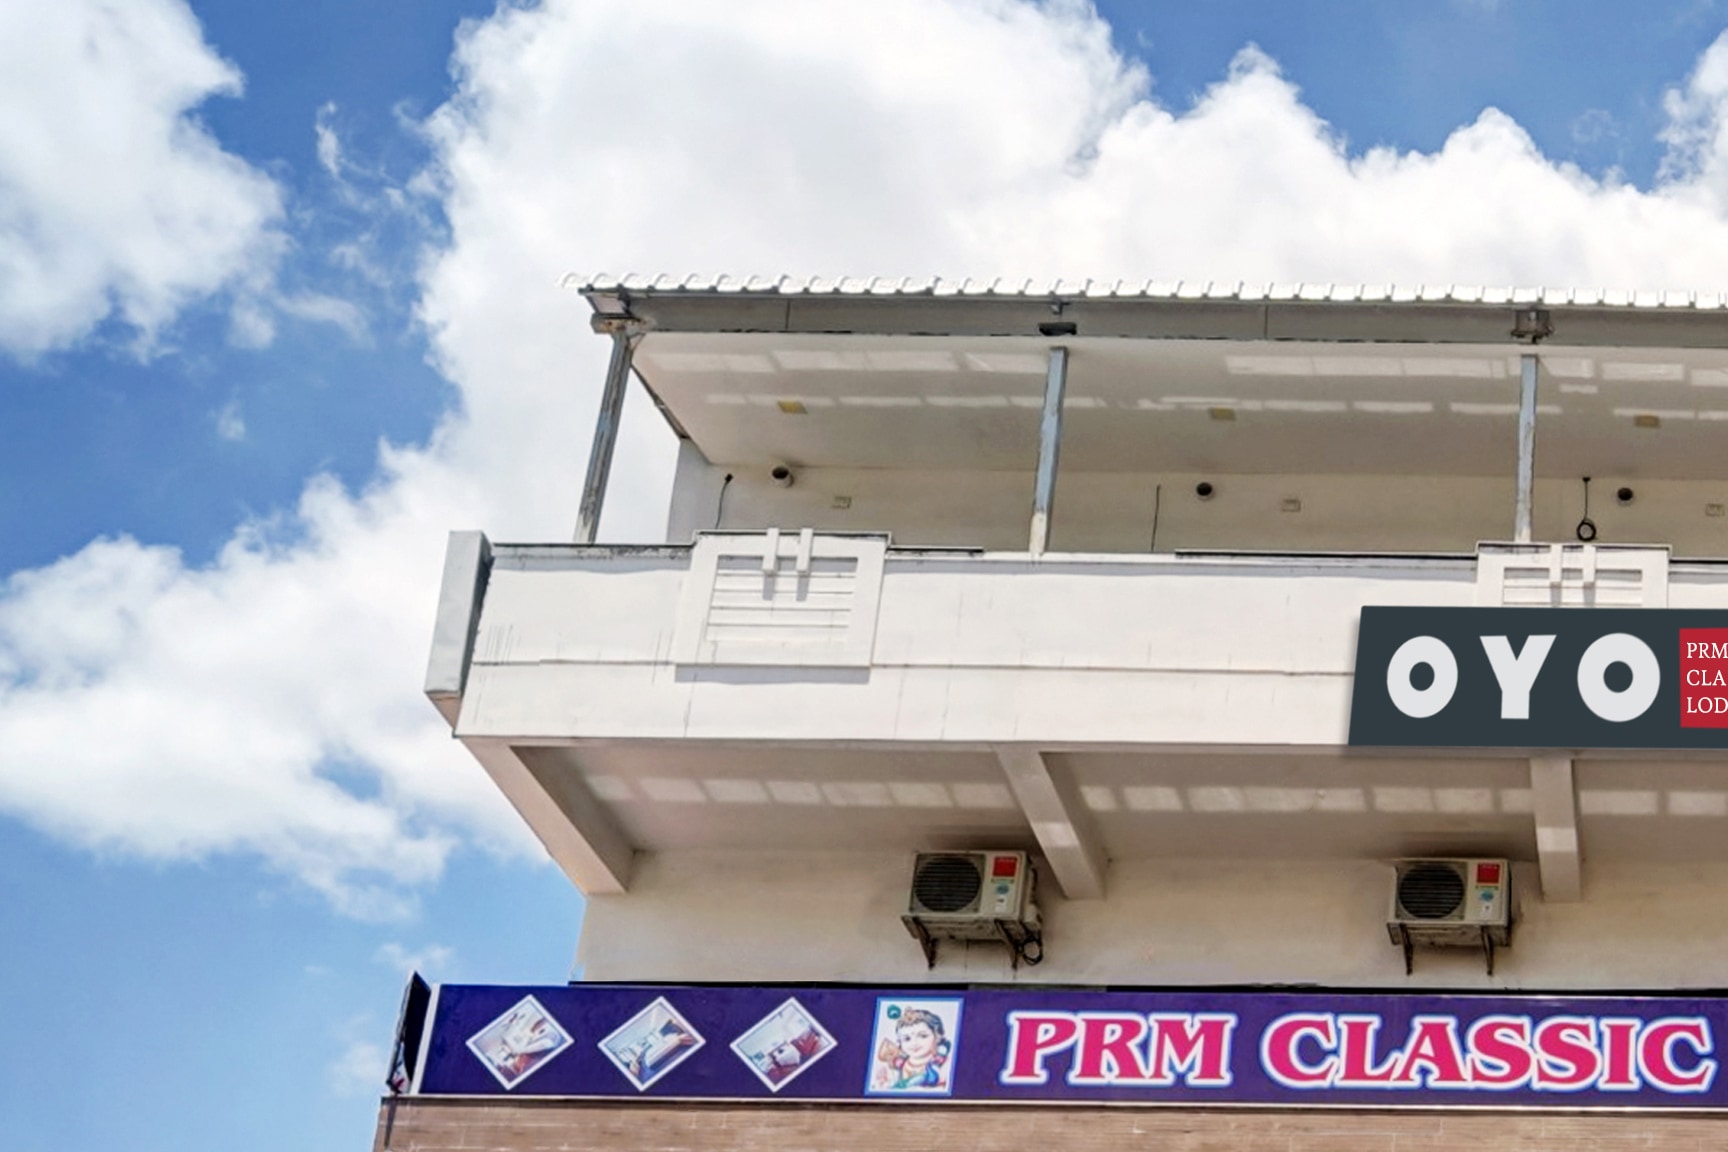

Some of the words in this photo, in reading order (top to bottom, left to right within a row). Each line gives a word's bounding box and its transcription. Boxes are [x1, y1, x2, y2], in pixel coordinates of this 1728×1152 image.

[1386, 632, 1660, 722] OYO
[1686, 641, 1728, 660] PRM
[999, 1010, 1237, 1086] PRM
[1262, 1013, 1716, 1092] CLASSIC
